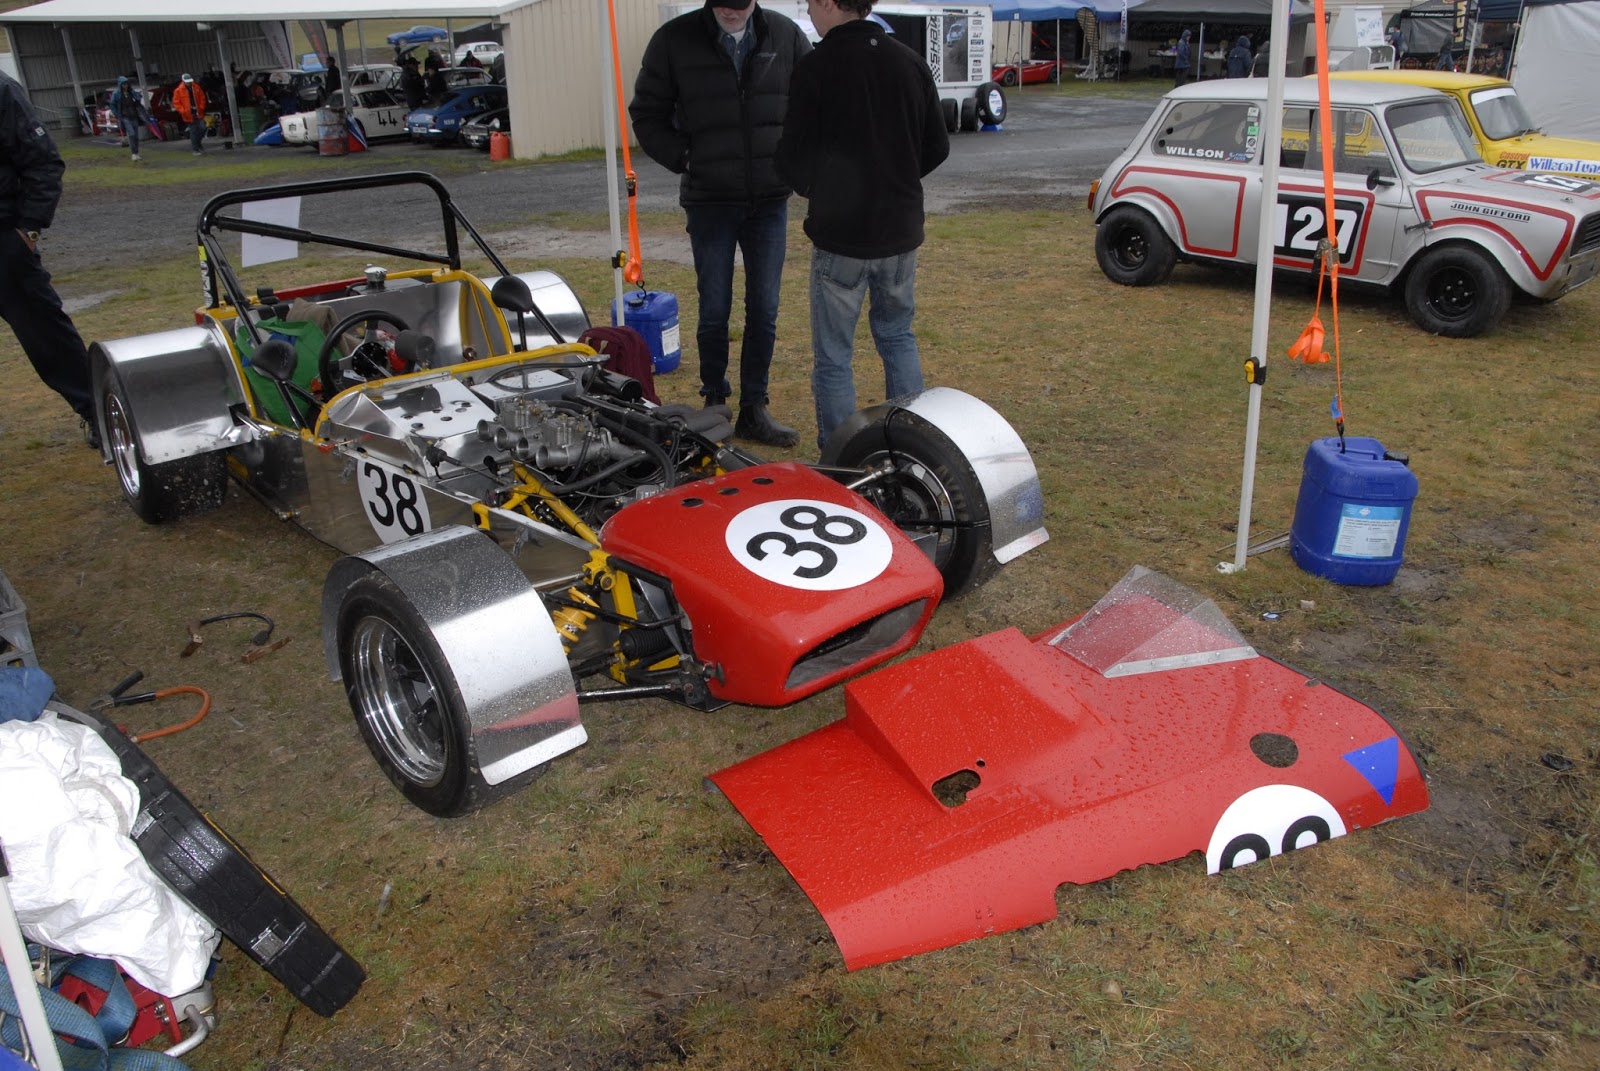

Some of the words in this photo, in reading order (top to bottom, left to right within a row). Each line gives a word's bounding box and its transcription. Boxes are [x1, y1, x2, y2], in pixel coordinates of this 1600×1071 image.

[377, 111, 398, 126] 44
[1166, 146, 1224, 158] WILLSON
[1500, 152, 1529, 160] Castrol
[1496, 160, 1526, 169] GTX
[1530, 158, 1573, 172] Willson
[1451, 203, 1480, 213] JOHN
[1482, 208, 1531, 221] GIFFORD
[1275, 204, 1357, 254] 127
[364, 462, 424, 536] 38
[746, 506, 867, 579] 38
